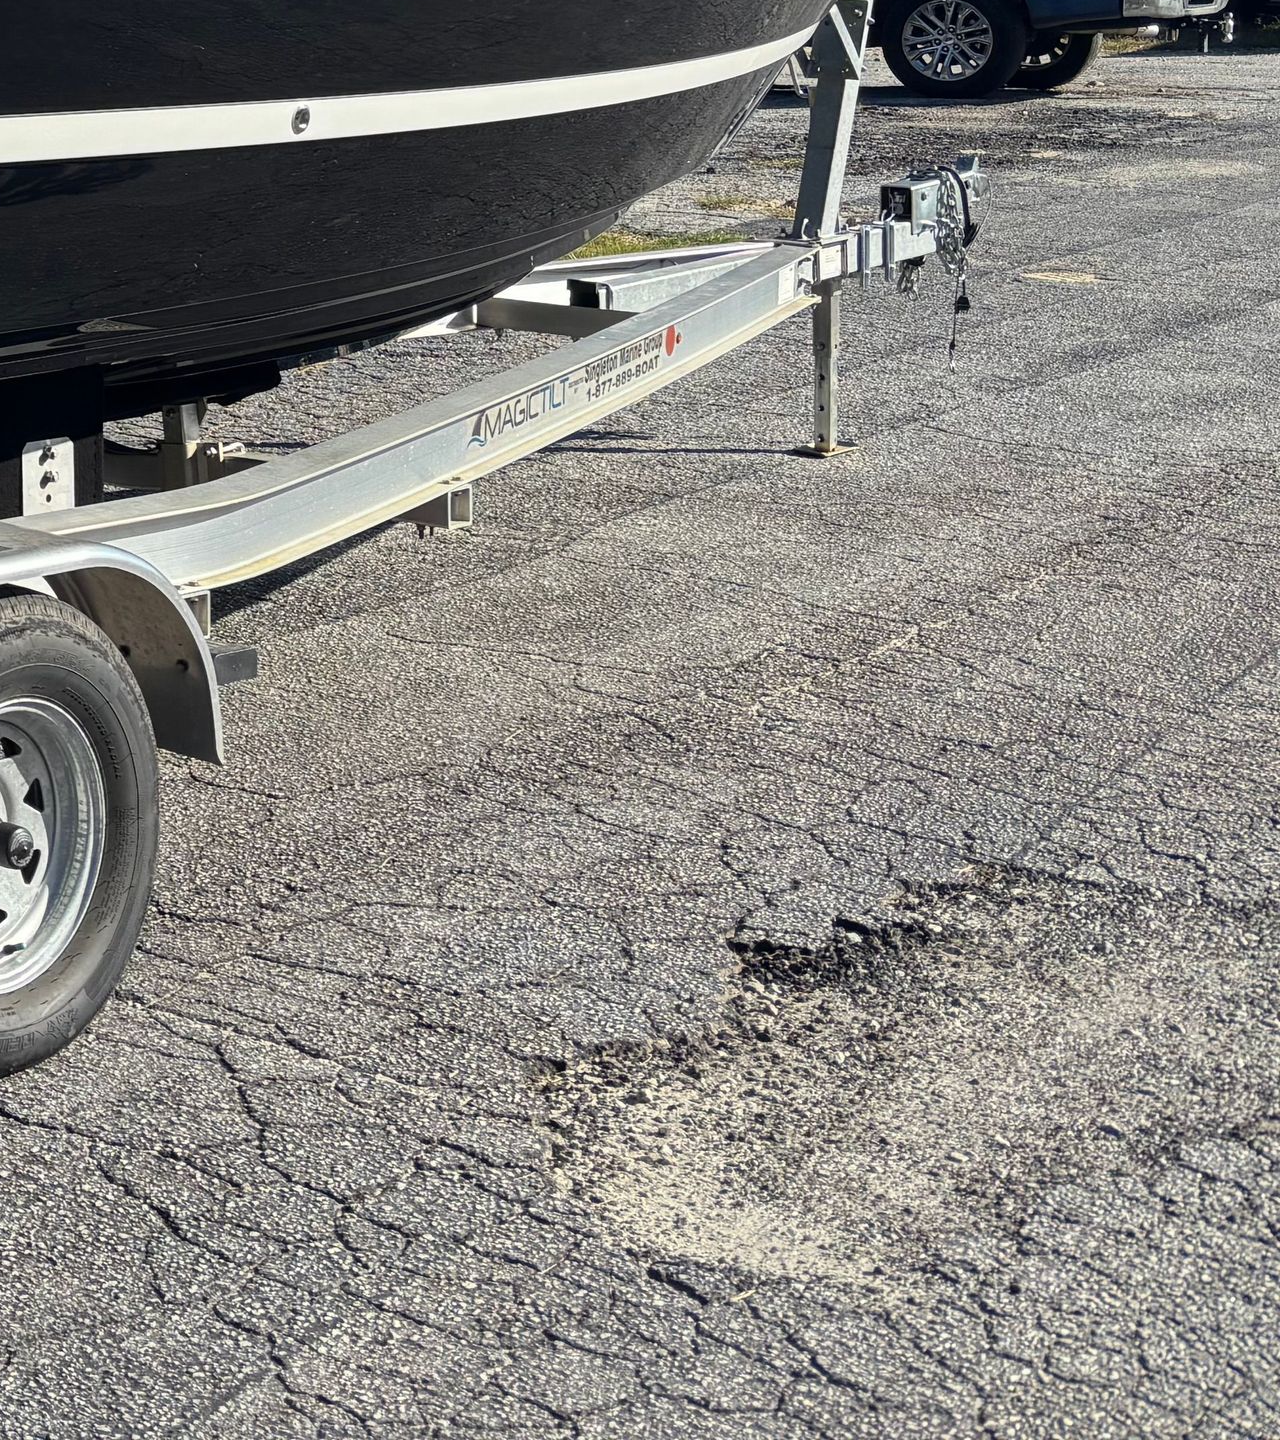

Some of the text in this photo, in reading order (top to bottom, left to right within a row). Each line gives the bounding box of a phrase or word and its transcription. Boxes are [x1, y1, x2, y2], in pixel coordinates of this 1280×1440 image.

[584, 333, 663, 384] Singleton Marine Group
[587, 355, 659, 402] 1-877-889-BOAT
[483, 376, 570, 440] MAGICTILT
